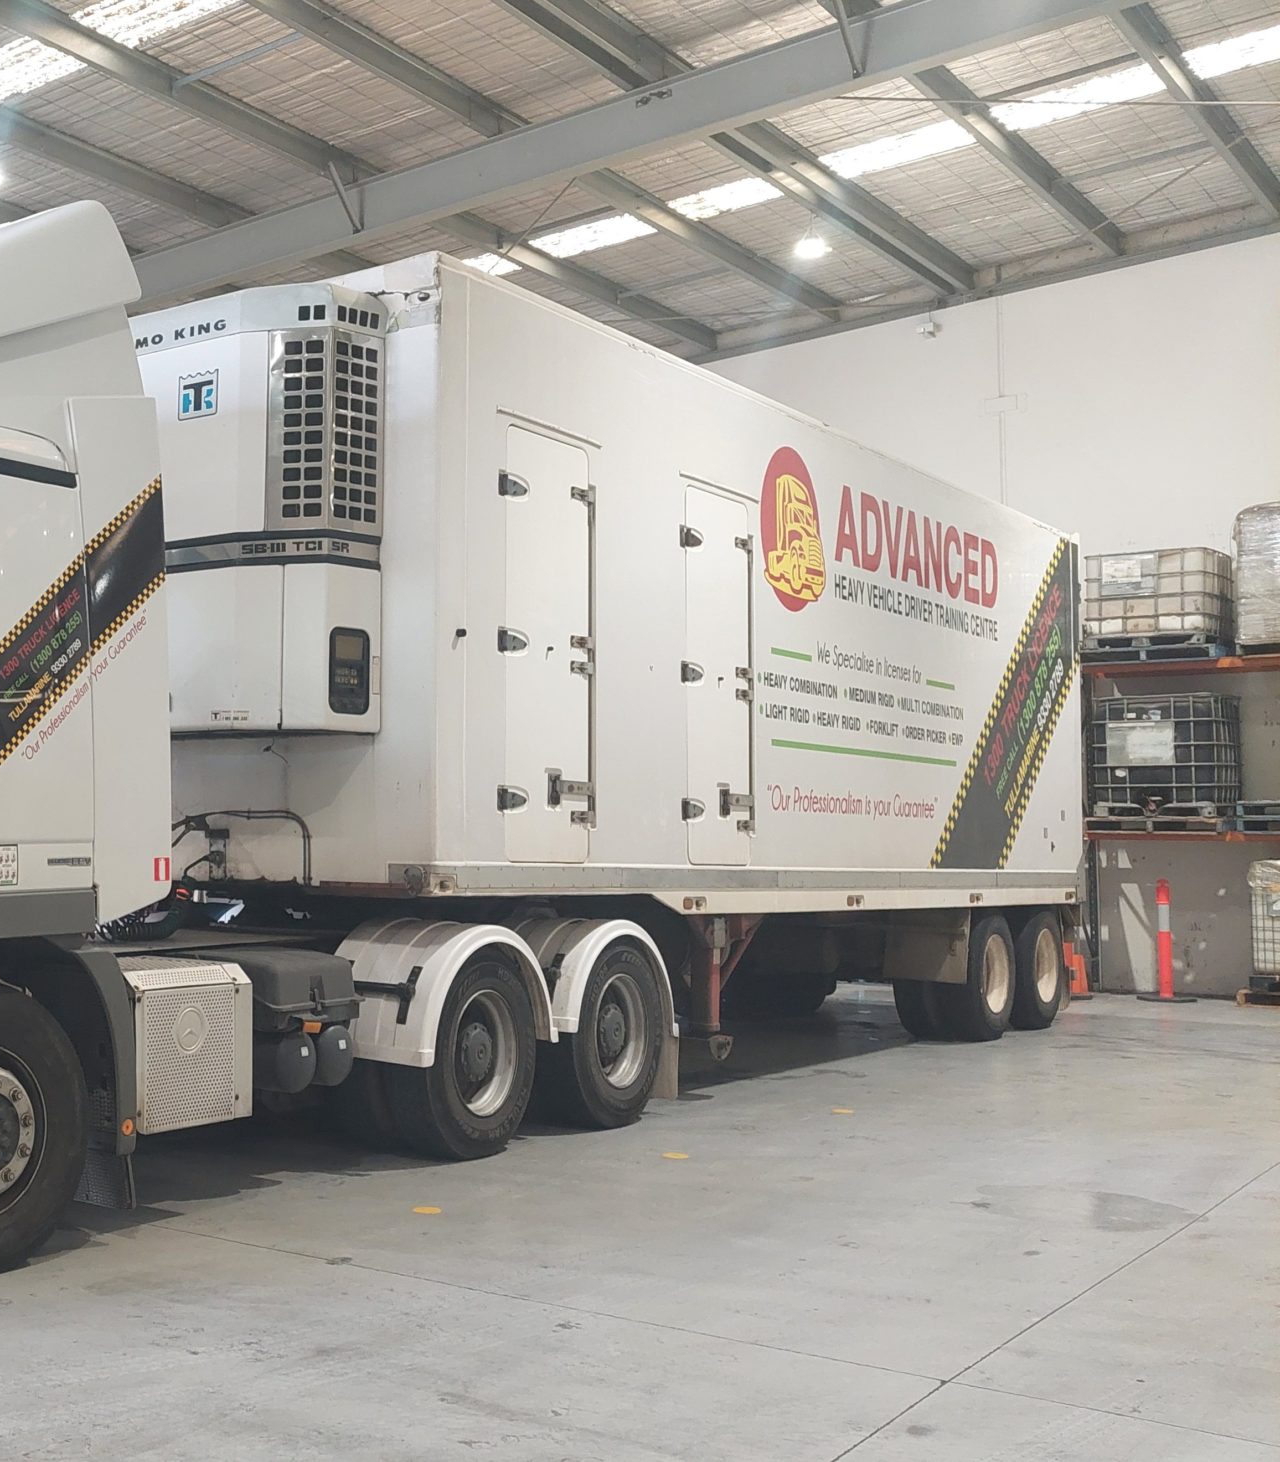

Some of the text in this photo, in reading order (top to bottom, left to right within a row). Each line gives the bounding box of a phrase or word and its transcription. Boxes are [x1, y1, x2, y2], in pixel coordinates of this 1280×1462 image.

[174, 319, 227, 341] KING
[292, 540, 322, 552] TCI
[331, 541, 350, 553] SR
[834, 485, 998, 609] ADVANCED
[834, 573, 998, 642] HEAVY VEHICLE DRIVER TRAINING CENTRE
[0, 656, 20, 680] 1300
[17, 627, 48, 659] TRUCK
[15, 672, 29, 686] CALL
[30, 647, 52, 674] (1300
[50, 629, 68, 650] 878
[66, 610, 84, 634] 255)
[816, 640, 922, 684] We Specialise in licenses for
[8, 638, 82, 722] TULLAMARINE 9330 2789
[764, 672, 964, 720] HEAVY COMBINATION MEDIUM RIGID MULTI COMBINATION
[984, 582, 1062, 786] 1300 TRUCK LICENCE
[1006, 744, 1020, 772] CALL
[1016, 690, 1038, 746] (1300
[1034, 659, 1048, 697] 878
[1046, 624, 1062, 666] 255)
[38, 681, 90, 744] Professionalism
[766, 702, 964, 746] LIGHT RIGID HEAVY RIGID FORKLIFT ORDER PICKER EWP
[1004, 658, 1064, 819] TULLAMARINE 9330 2789
[793, 786, 862, 815] Professionalism
[864, 795, 871, 816] is
[874, 800, 891, 820] your
